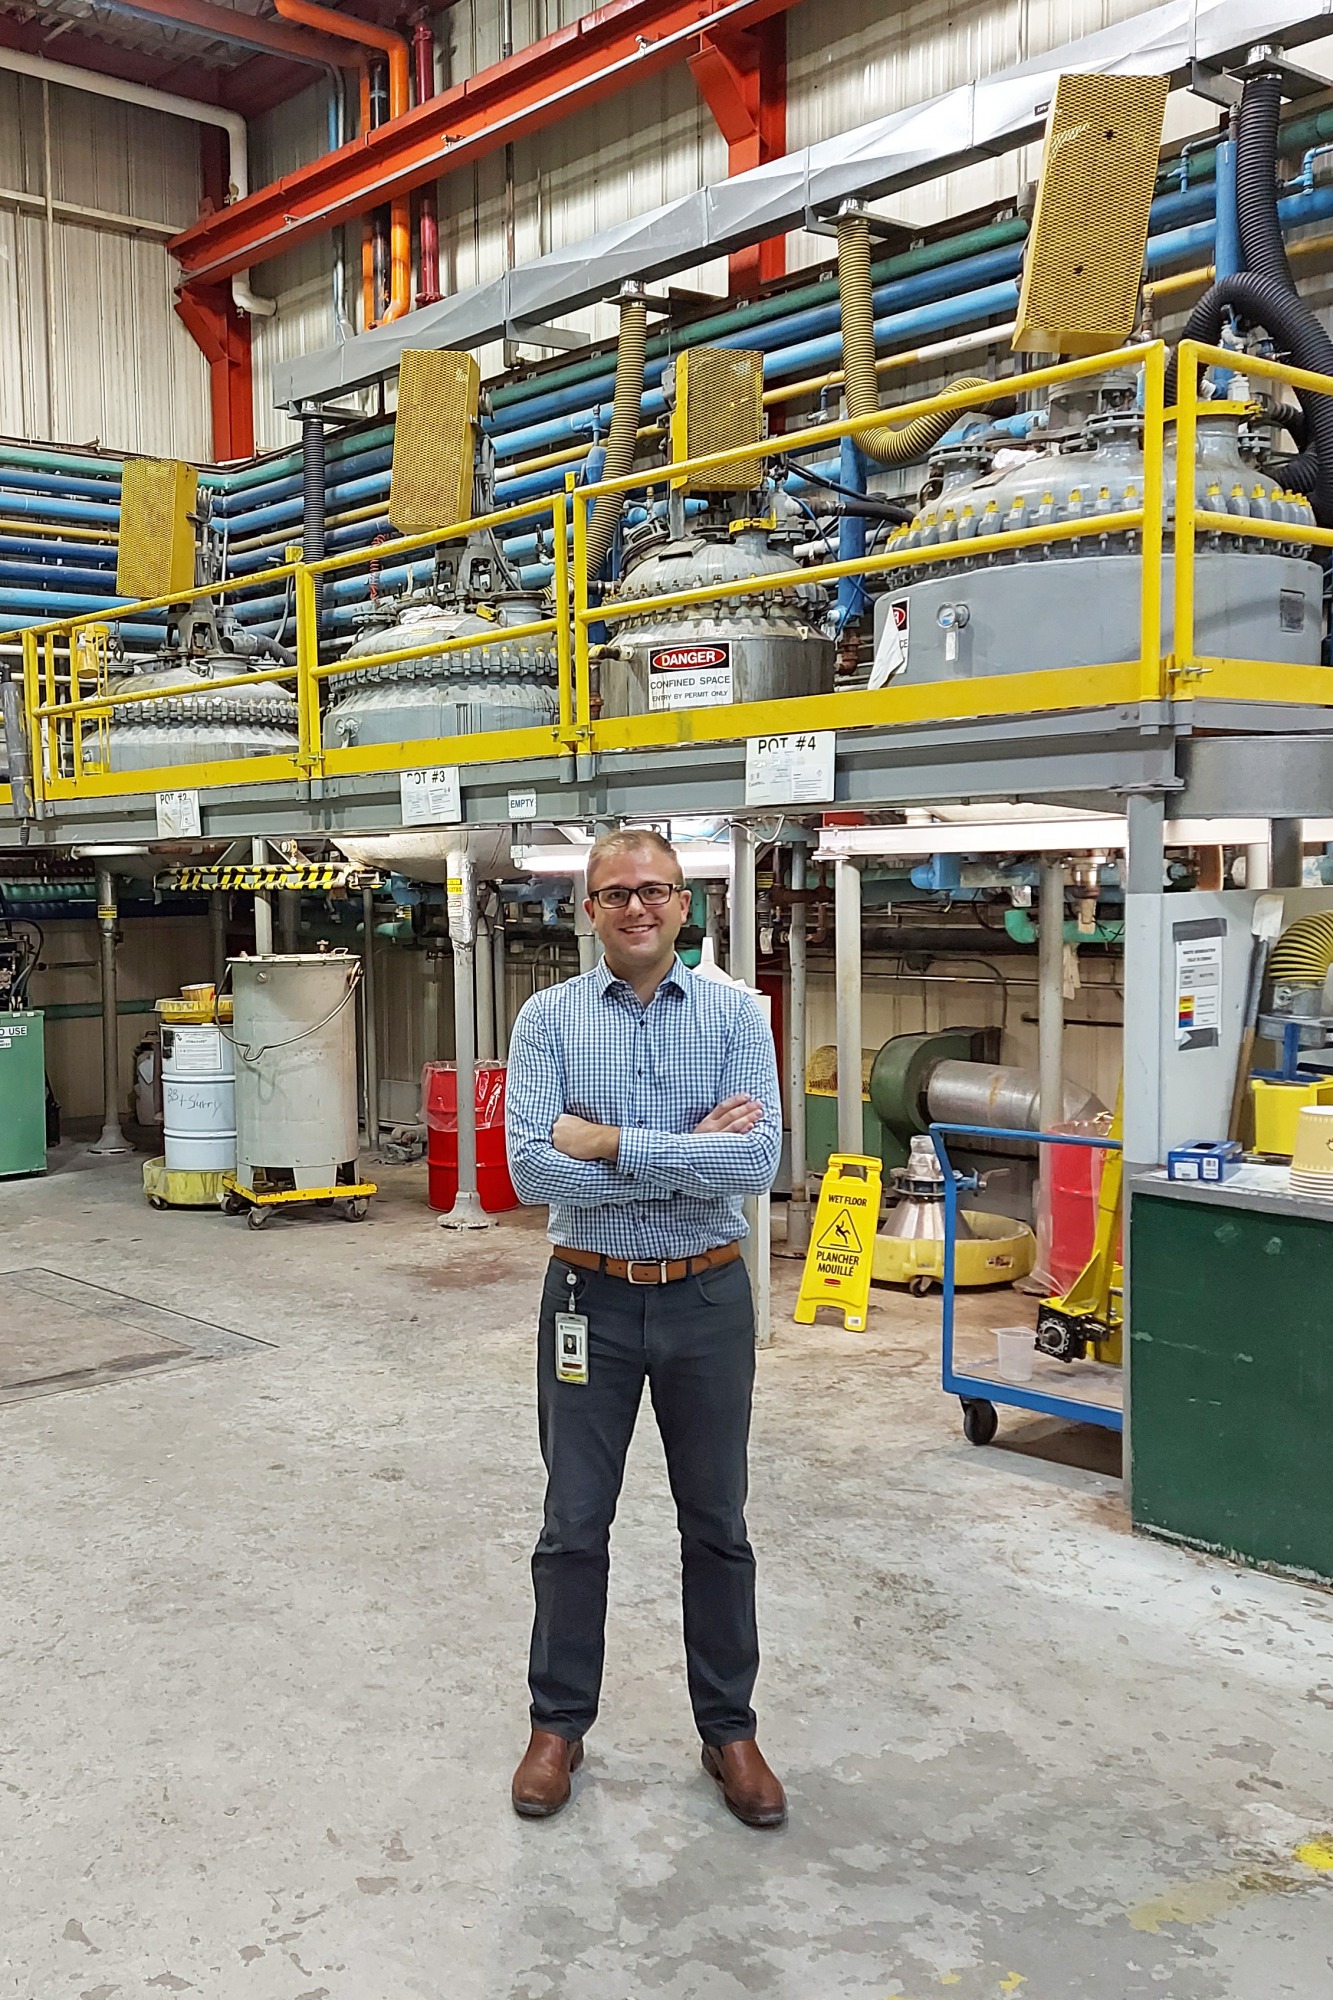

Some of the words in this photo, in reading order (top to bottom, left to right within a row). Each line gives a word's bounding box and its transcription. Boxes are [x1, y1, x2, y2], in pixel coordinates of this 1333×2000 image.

[661, 651, 716, 666] DANGER
[650, 678, 695, 690] CONFINED
[699, 675, 731, 685] SPACE
[652, 694, 672, 702] ENTRY
[684, 691, 709, 699] PERMIT
[758, 737, 789, 754] POT
[795, 736, 816, 751] #4
[431, 770, 446, 783] #3
[160, 793, 174, 805] POT
[510, 798, 535, 809] EMPTY
[8, 1026, 27, 1036] USE
[827, 1194, 844, 1204] WET
[845, 1196, 868, 1207] FLOOR
[816, 1252, 859, 1266] PLANCHER
[817, 1262, 854, 1277] MOUILLÉ
